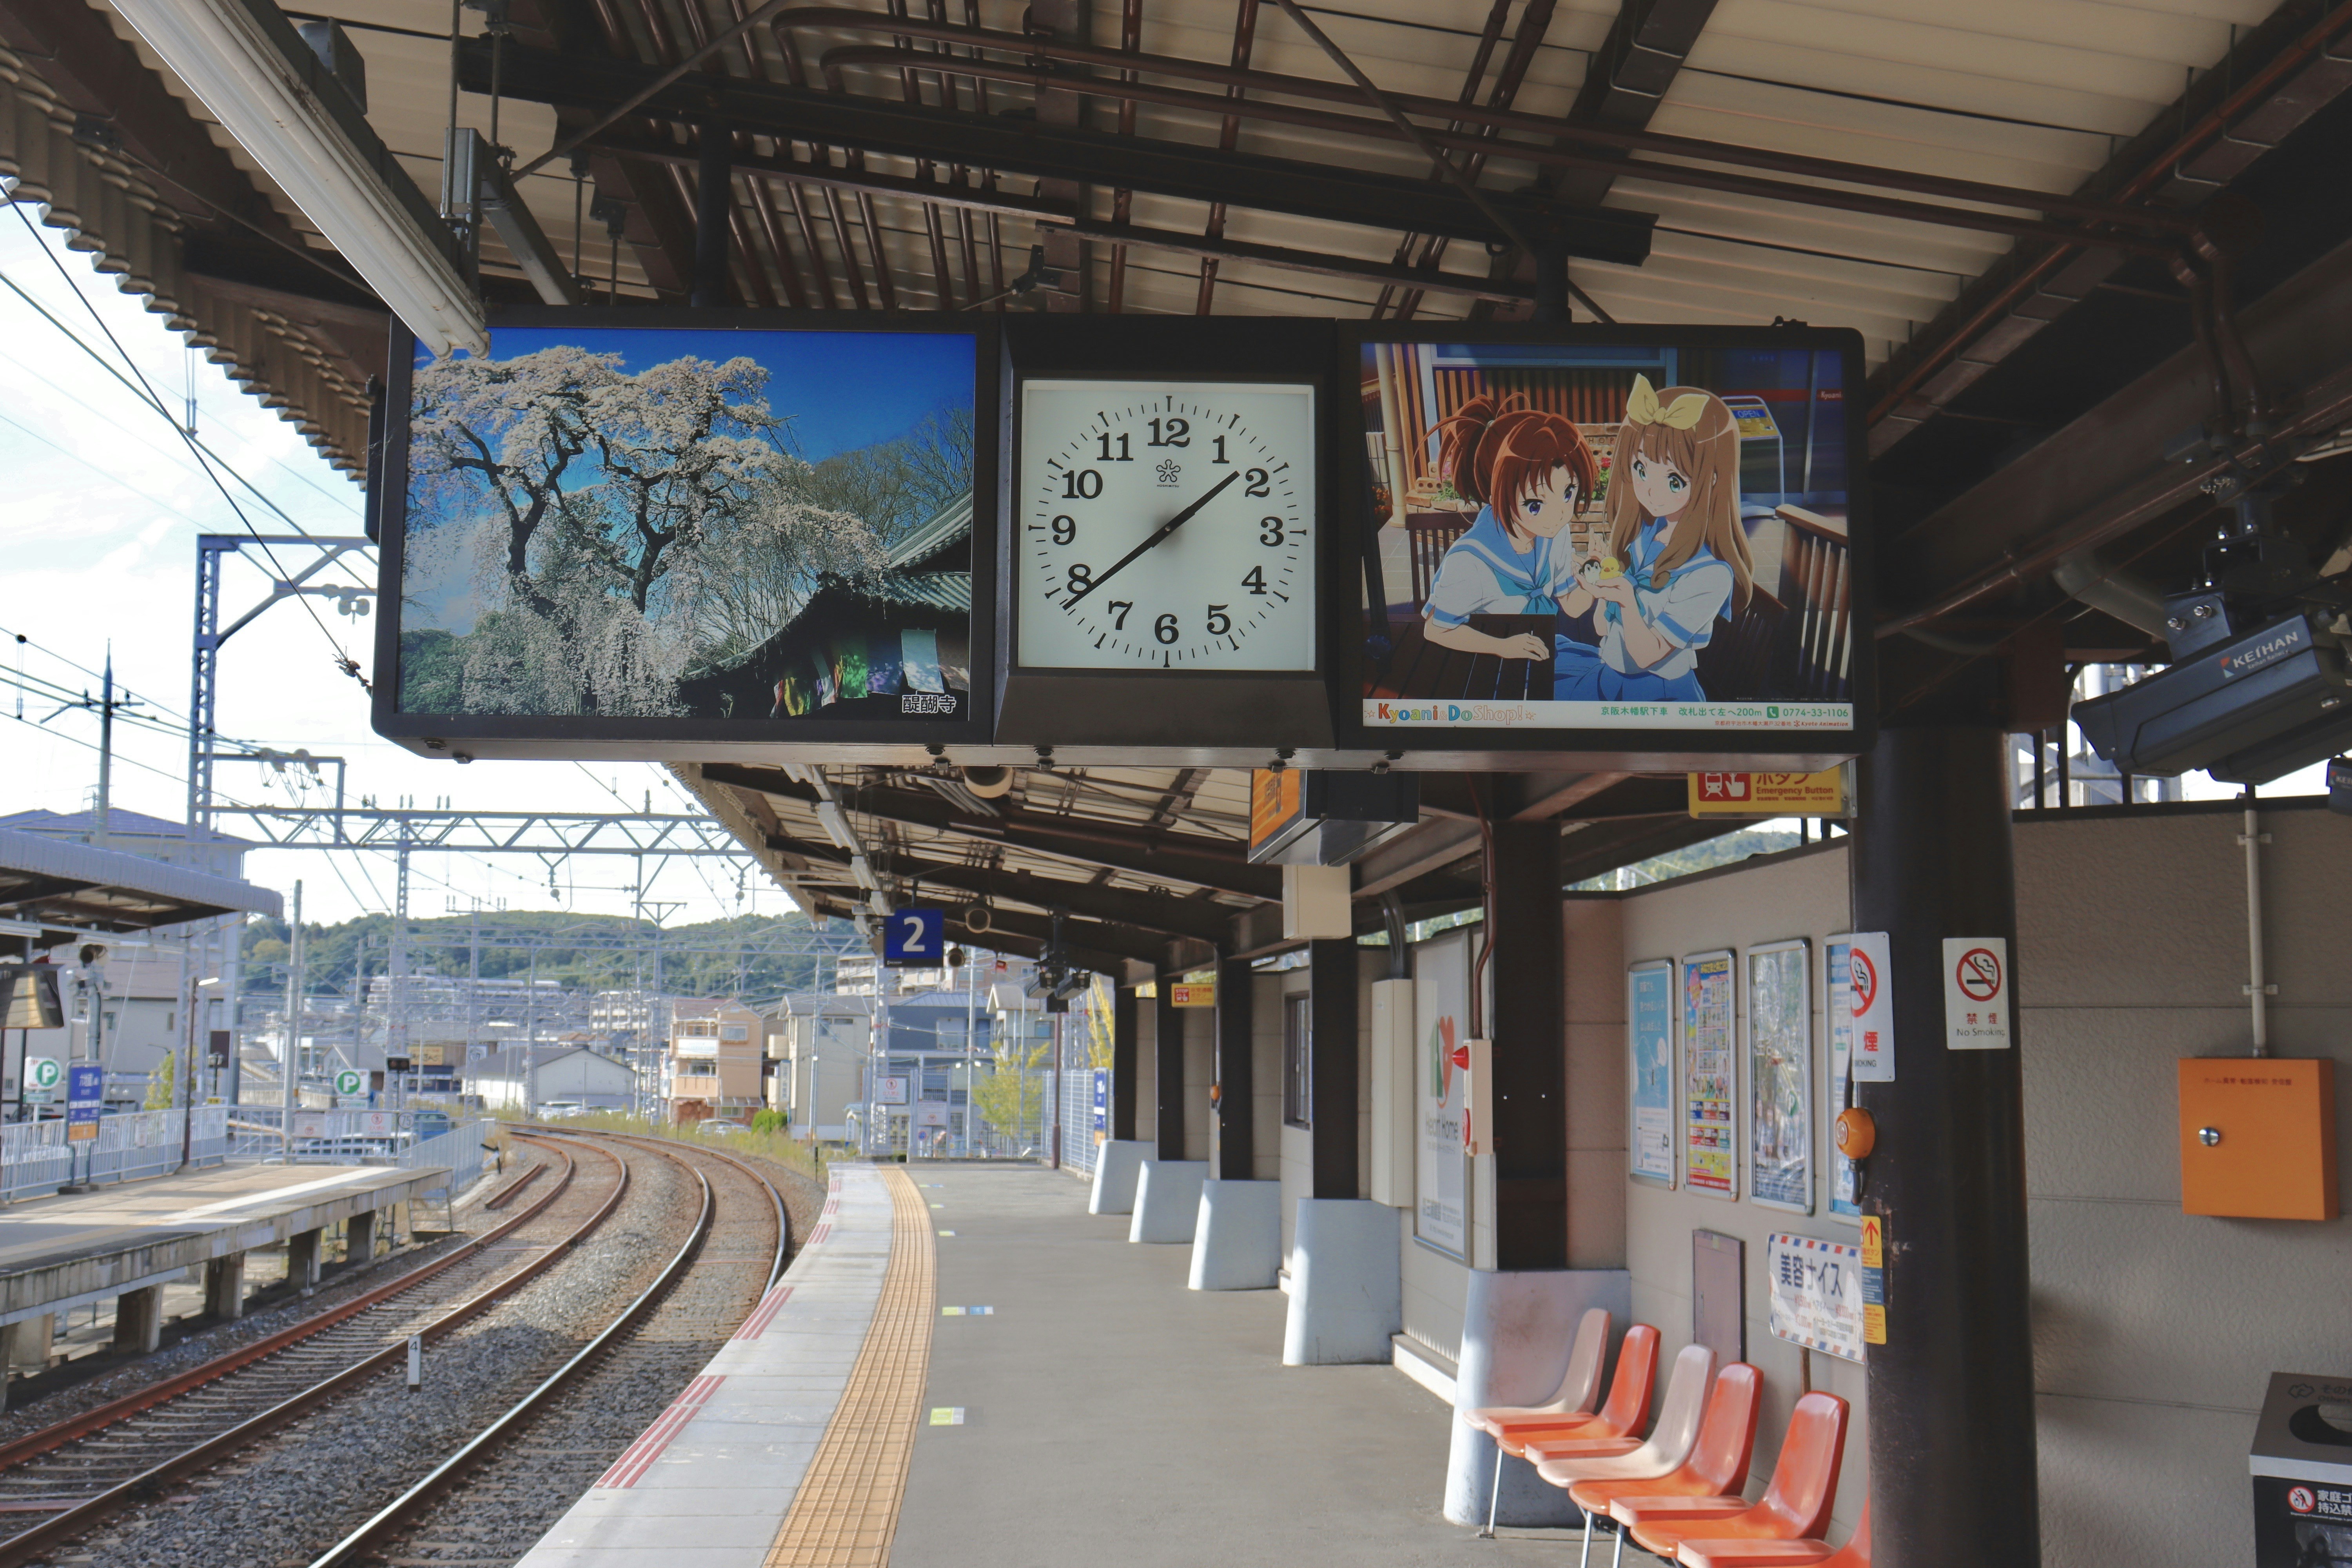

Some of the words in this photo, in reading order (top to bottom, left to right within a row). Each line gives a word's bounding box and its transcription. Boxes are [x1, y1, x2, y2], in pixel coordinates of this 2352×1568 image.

[1737, 410, 1760, 418] OPEN
[1097, 432, 1133, 461] 11
[1147, 417, 1190, 447] 12
[1212, 435, 1229, 463] 1
[1062, 469, 1103, 499] 10
[1245, 468, 1270, 497] 2
[1052, 515, 1076, 545] 9
[1260, 516, 1284, 546] 3
[1067, 564, 1092, 594] 8
[1241, 566, 1267, 594] 4
[1108, 601, 1133, 630] 7
[1154, 614, 1179, 644] 6
[1207, 604, 1230, 635] 5
[2232, 631, 2298, 668] KEIHAN
[902, 695, 956, 713] 醍醐寺
[1601, 707, 1668, 716] 京阪木幡駅下車
[1783, 708, 1848, 717] 0774-33-1106
[1757, 787, 1802, 795] Emergency
[902, 916, 925, 952] 2
[1966, 1013, 1997, 1025] 禁煙
[1973, 1027, 2005, 1038] Smoking
[1864, 1031, 1879, 1052] 煙
[42, 1064, 55, 1083] P
[343, 1075, 357, 1092] P
[1426, 1111, 1441, 1138] Heart
[1442, 1113, 1458, 1141] Home
